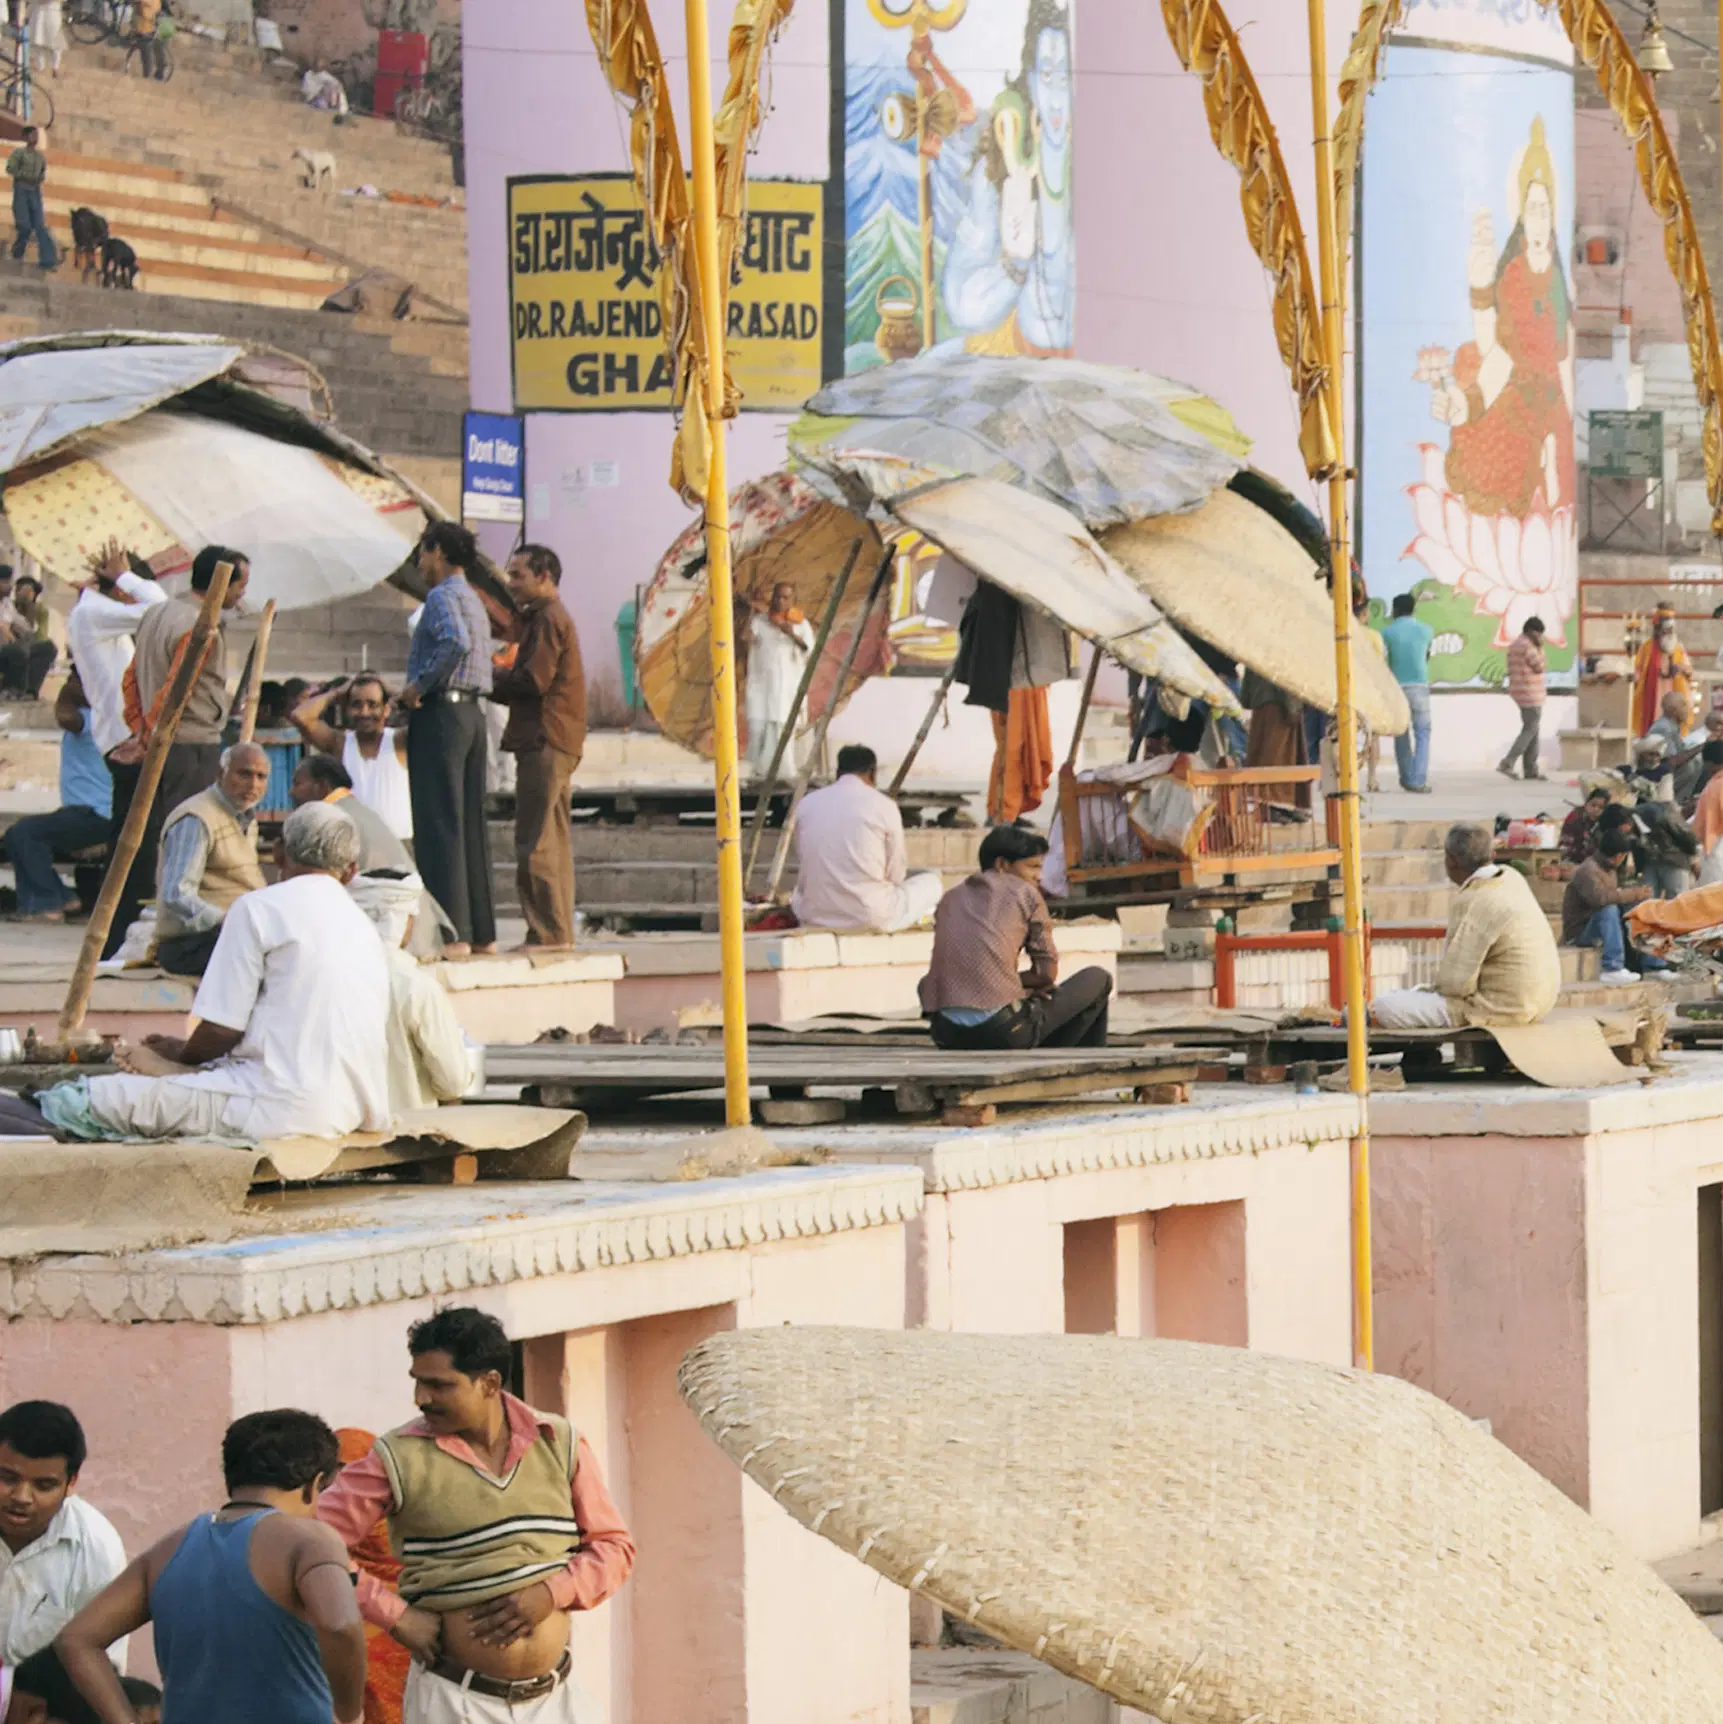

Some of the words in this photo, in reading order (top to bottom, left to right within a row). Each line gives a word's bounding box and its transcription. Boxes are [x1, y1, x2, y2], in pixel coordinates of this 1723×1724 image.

[516, 299, 662, 339] DR.RAJEND
[727, 301, 817, 339] RASAD
[567, 352, 674, 396] GHA
